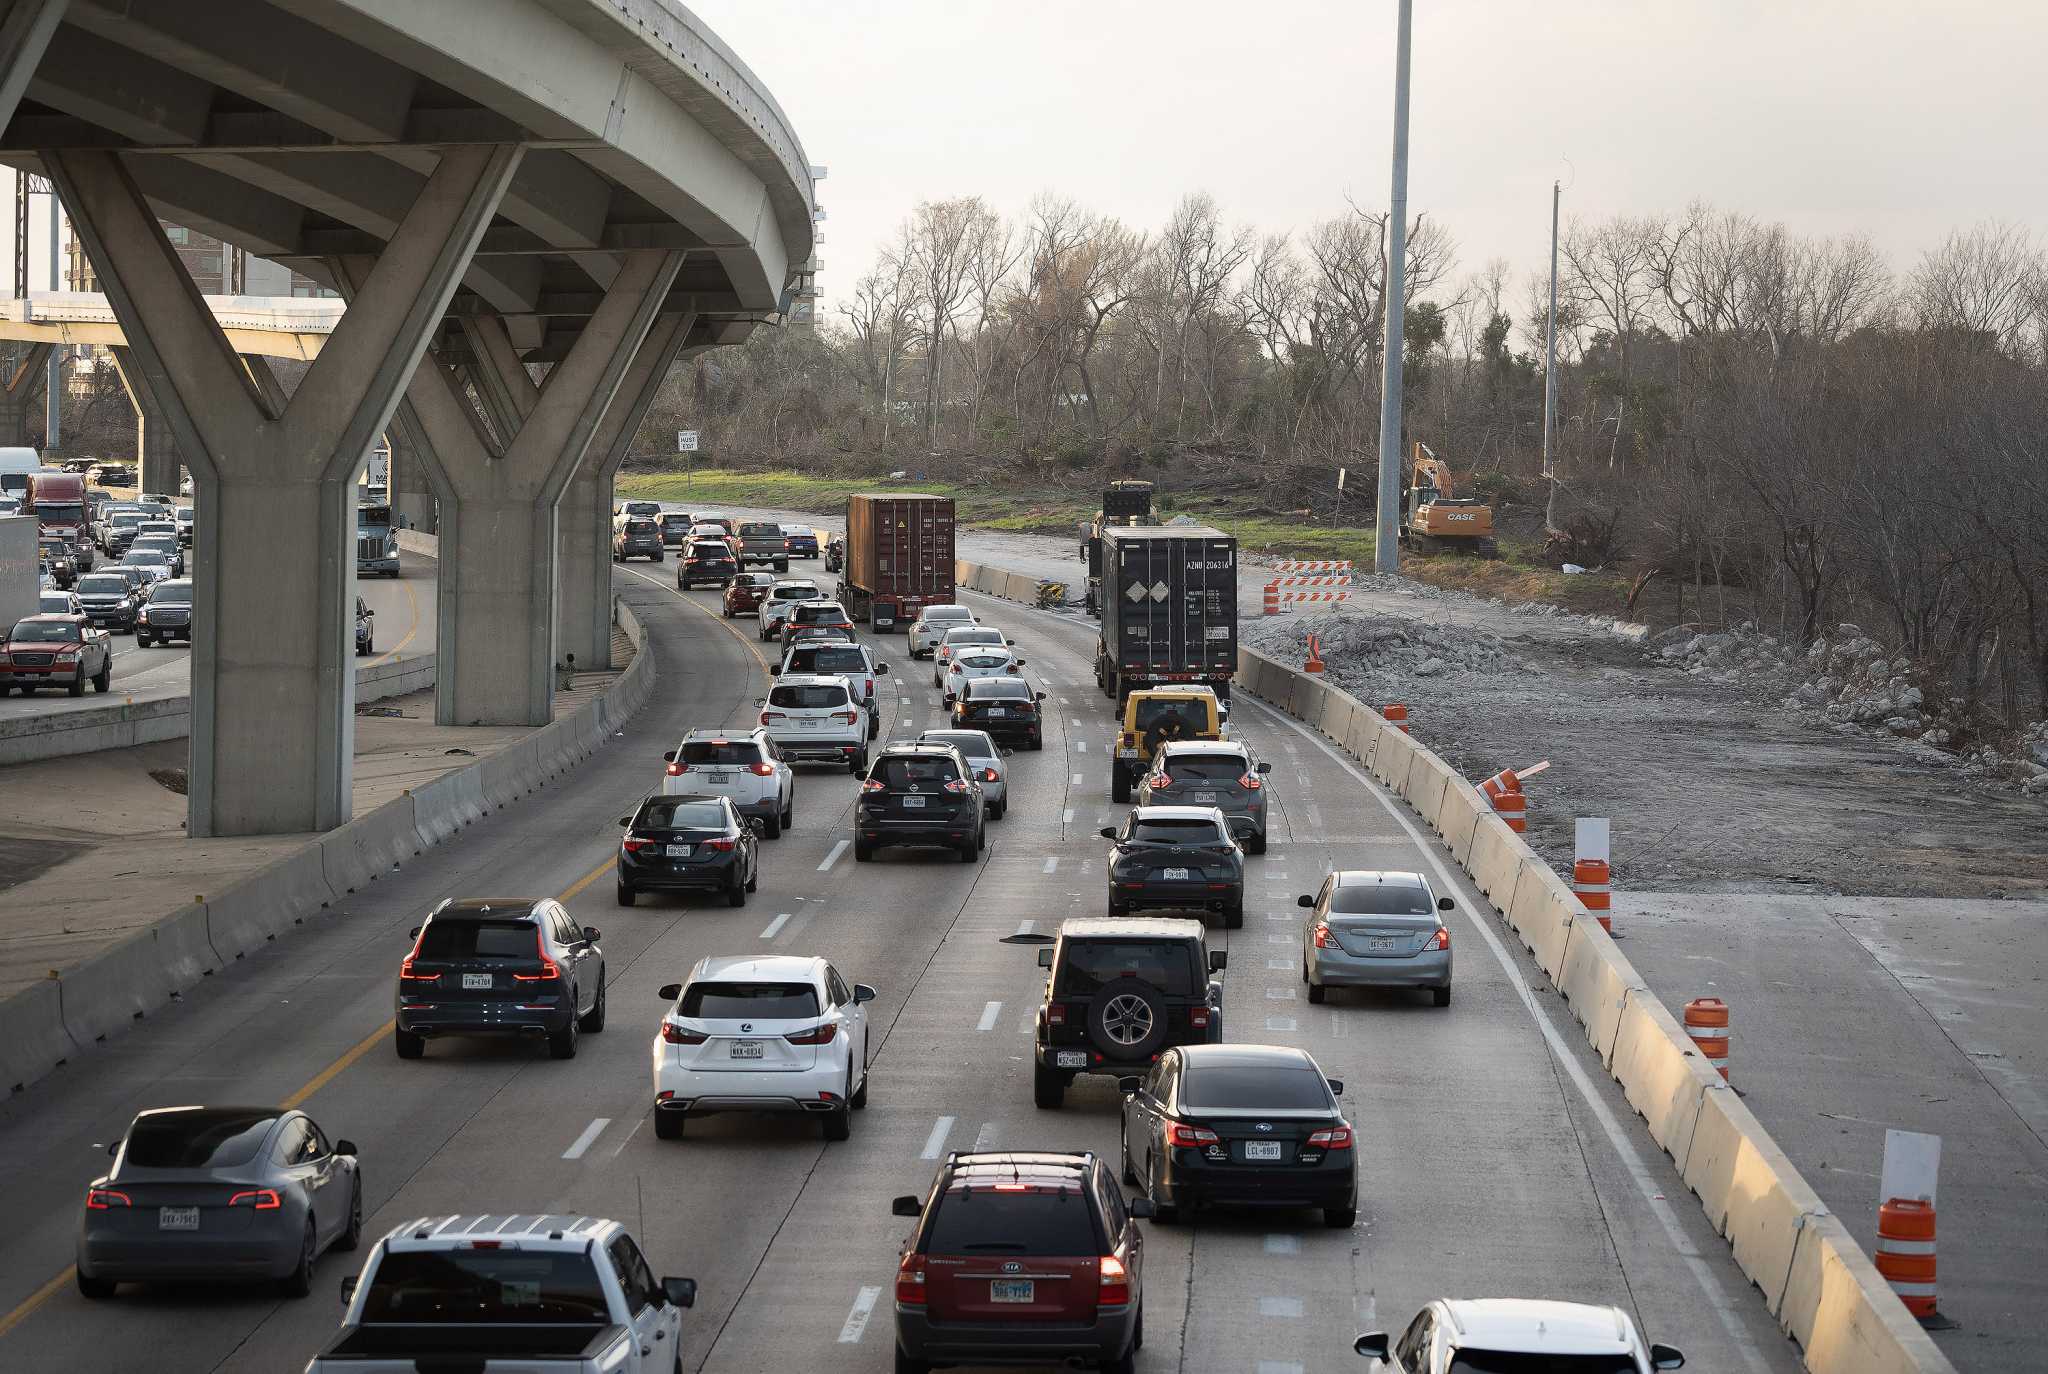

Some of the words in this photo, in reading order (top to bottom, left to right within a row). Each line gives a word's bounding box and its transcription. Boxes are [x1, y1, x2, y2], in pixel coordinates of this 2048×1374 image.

[1447, 512, 1476, 520] CASE
[1186, 561, 1203, 570] AZNU
[1206, 561, 1229, 570] 206316
